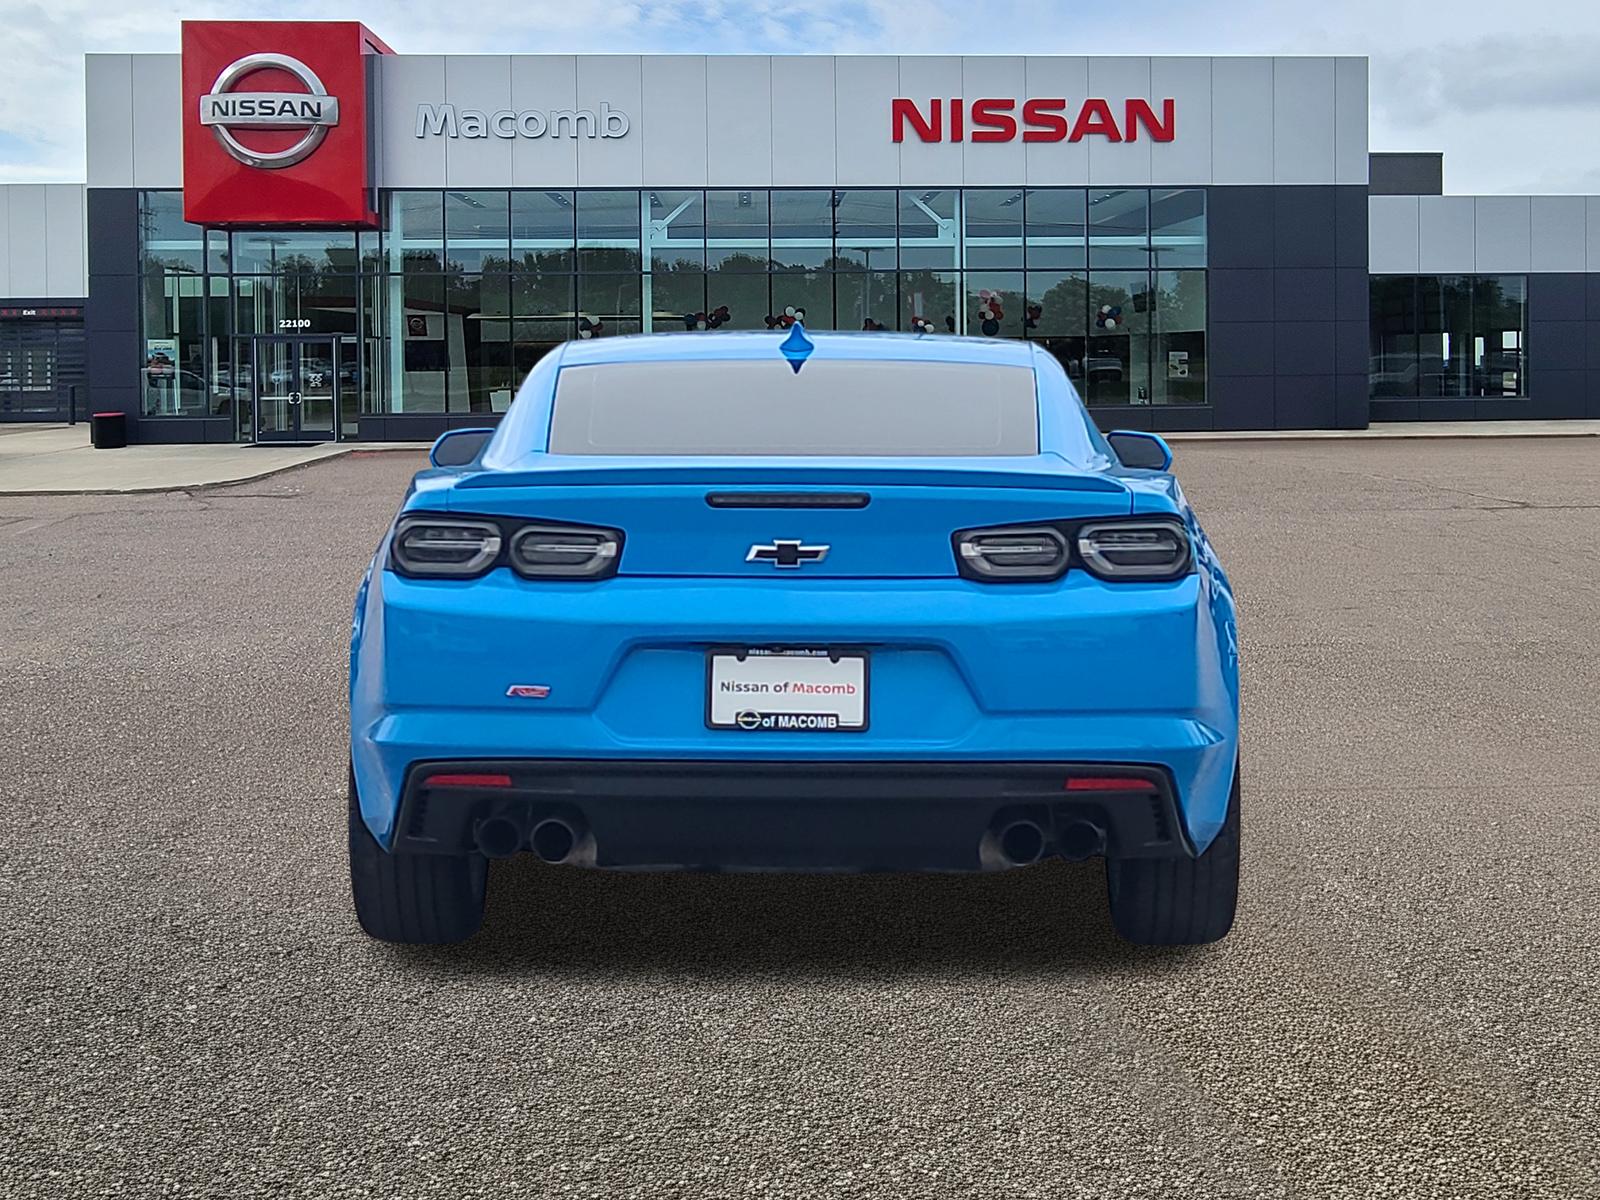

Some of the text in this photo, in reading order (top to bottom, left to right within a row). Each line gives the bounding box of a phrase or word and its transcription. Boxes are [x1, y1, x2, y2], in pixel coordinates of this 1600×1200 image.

[211, 100, 322, 117] NISSAN
[415, 102, 630, 139] Macomb
[892, 98, 1175, 143] NISSAN
[279, 319, 311, 328] 22100
[720, 681, 856, 695] Nissan of Macomb
[762, 716, 837, 729] of MACOMB
